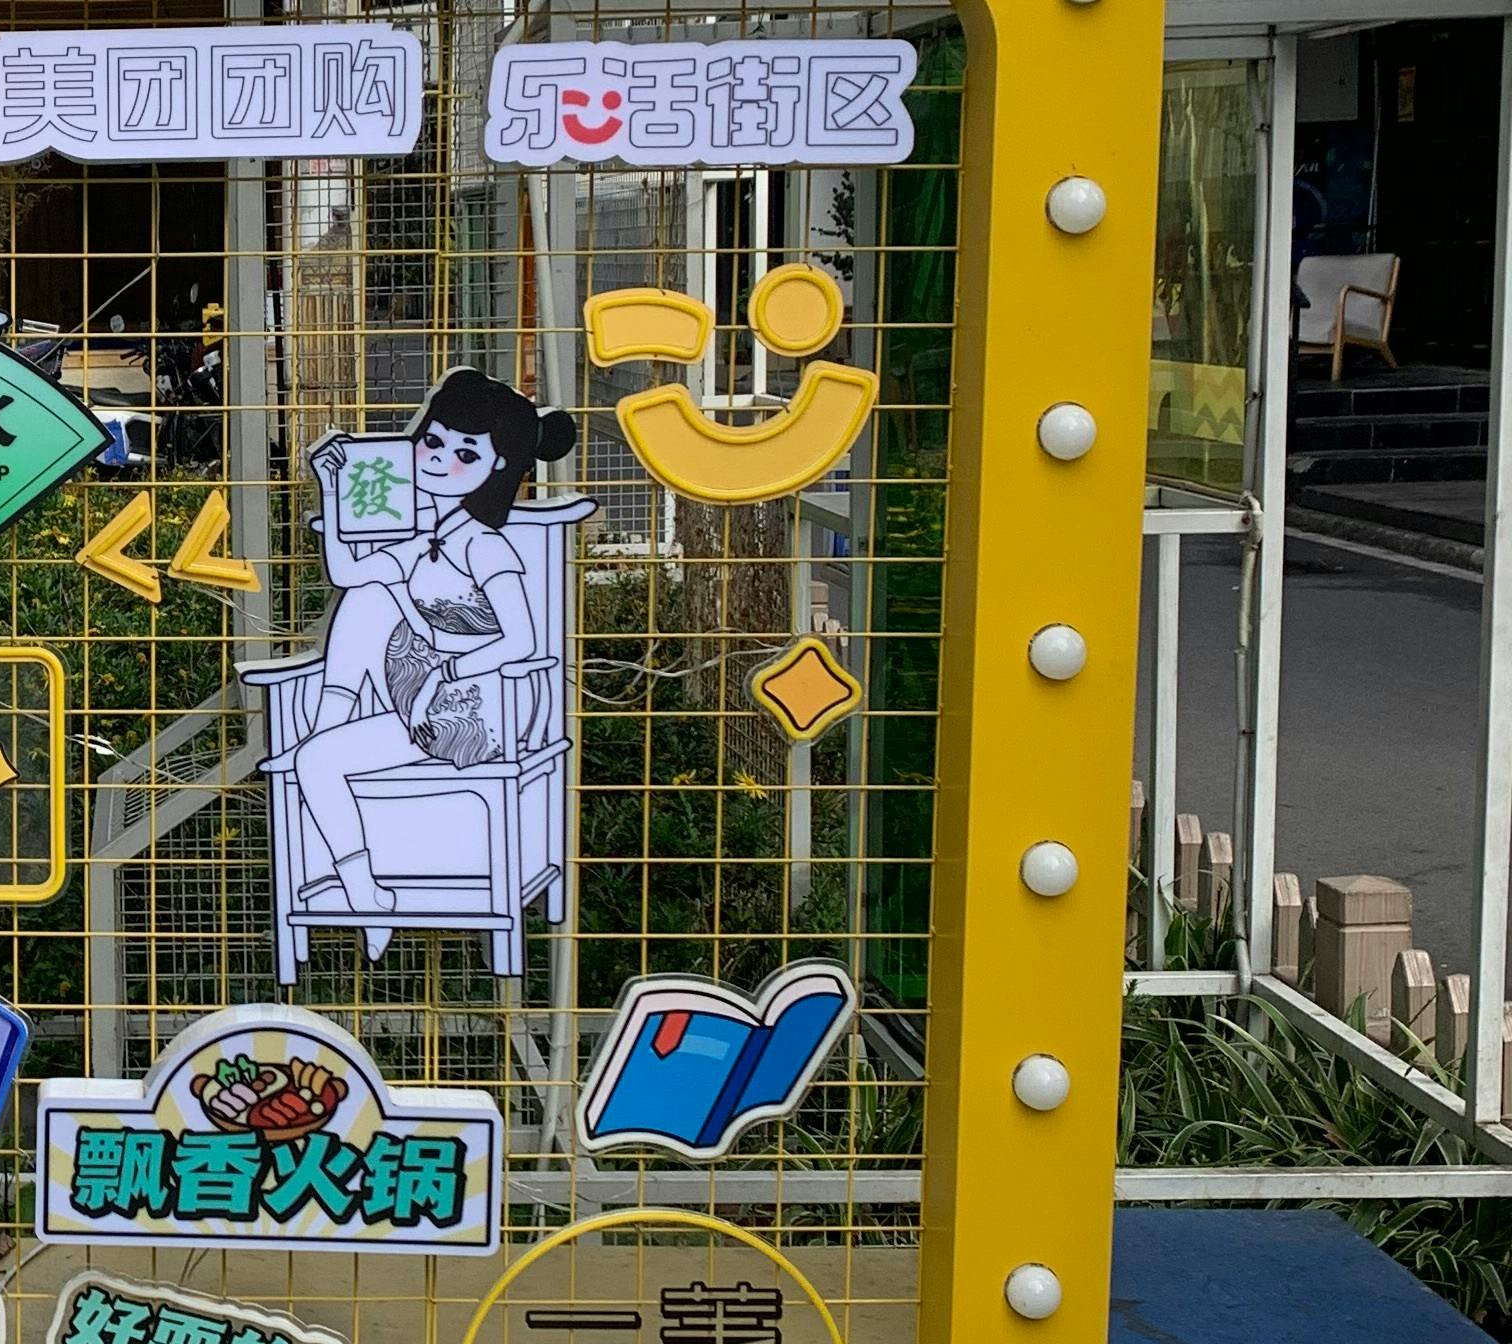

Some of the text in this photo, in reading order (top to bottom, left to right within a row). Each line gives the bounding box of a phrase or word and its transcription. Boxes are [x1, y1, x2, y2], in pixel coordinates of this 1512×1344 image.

[1, 39, 407, 145] 美团团购
[500, 55, 902, 150] 乐活街区
[340, 456, 412, 521] 發
[71, 1126, 469, 1227] 飘香火锅
